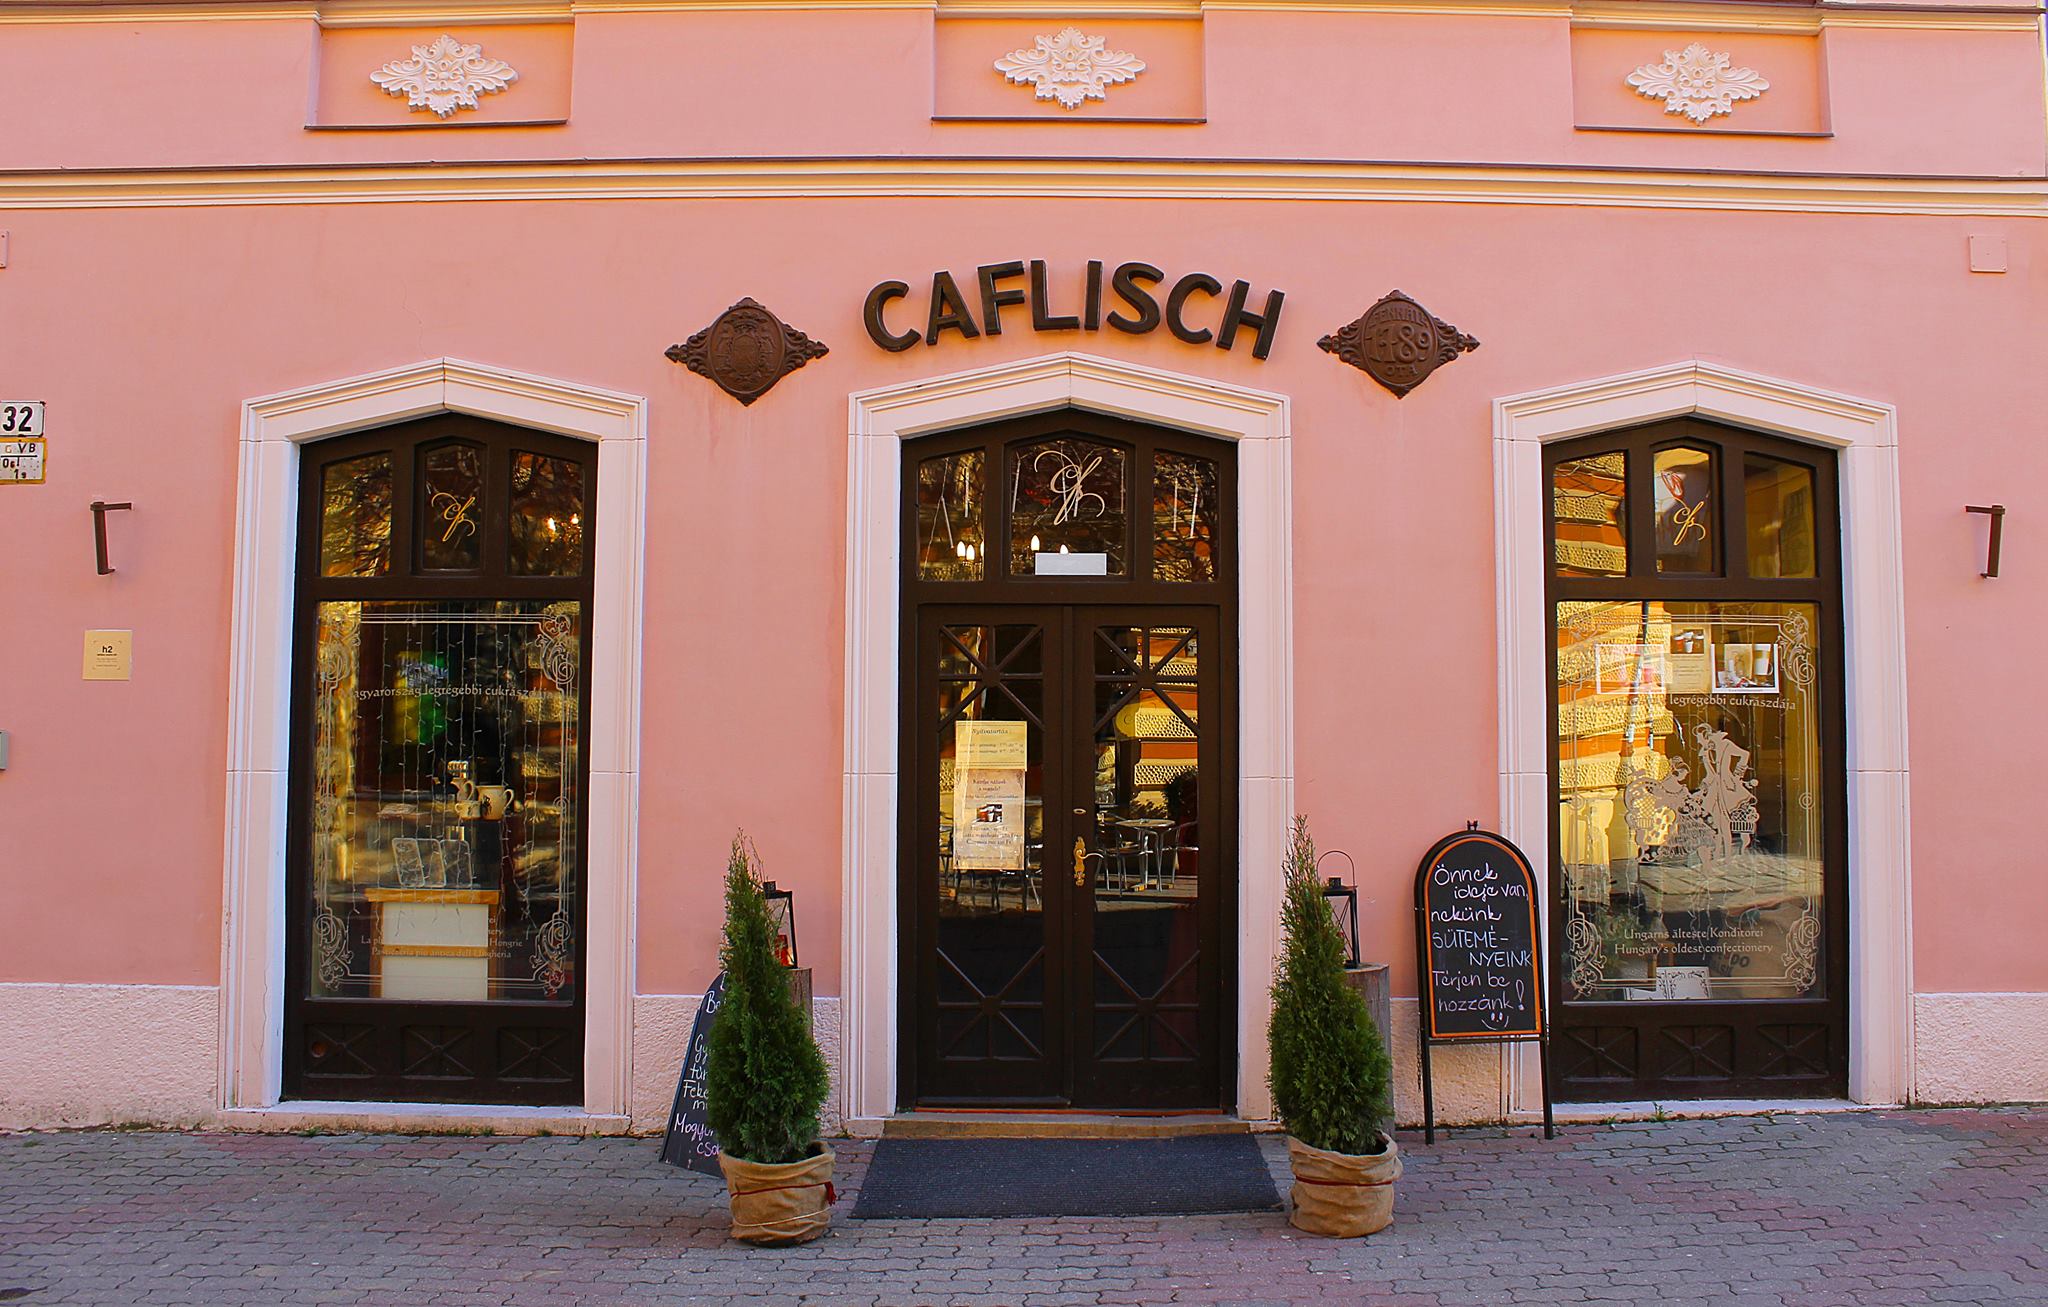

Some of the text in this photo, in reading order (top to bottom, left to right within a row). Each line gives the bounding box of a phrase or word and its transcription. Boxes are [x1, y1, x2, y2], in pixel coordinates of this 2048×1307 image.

[863, 259, 1286, 360] CAFLISCH
[1365, 324, 1433, 363] 1789
[2, 406, 33, 432] 32
[102, 645, 113, 653] h2
[424, 684, 482, 698] legrégebbi
[1670, 693, 1726, 707] legrégebbi
[1729, 695, 1796, 710] cukrászdája
[1434, 863, 1499, 885] Önnek
[1454, 881, 1499, 903] ideje
[1431, 905, 1502, 922] nekünk
[1710, 927, 1764, 939] Konditorei
[1614, 943, 1774, 956] Hungary's oldest confectionery
[1469, 951, 1533, 968] NYEINK
[1432, 970, 1511, 992] Térjen be
